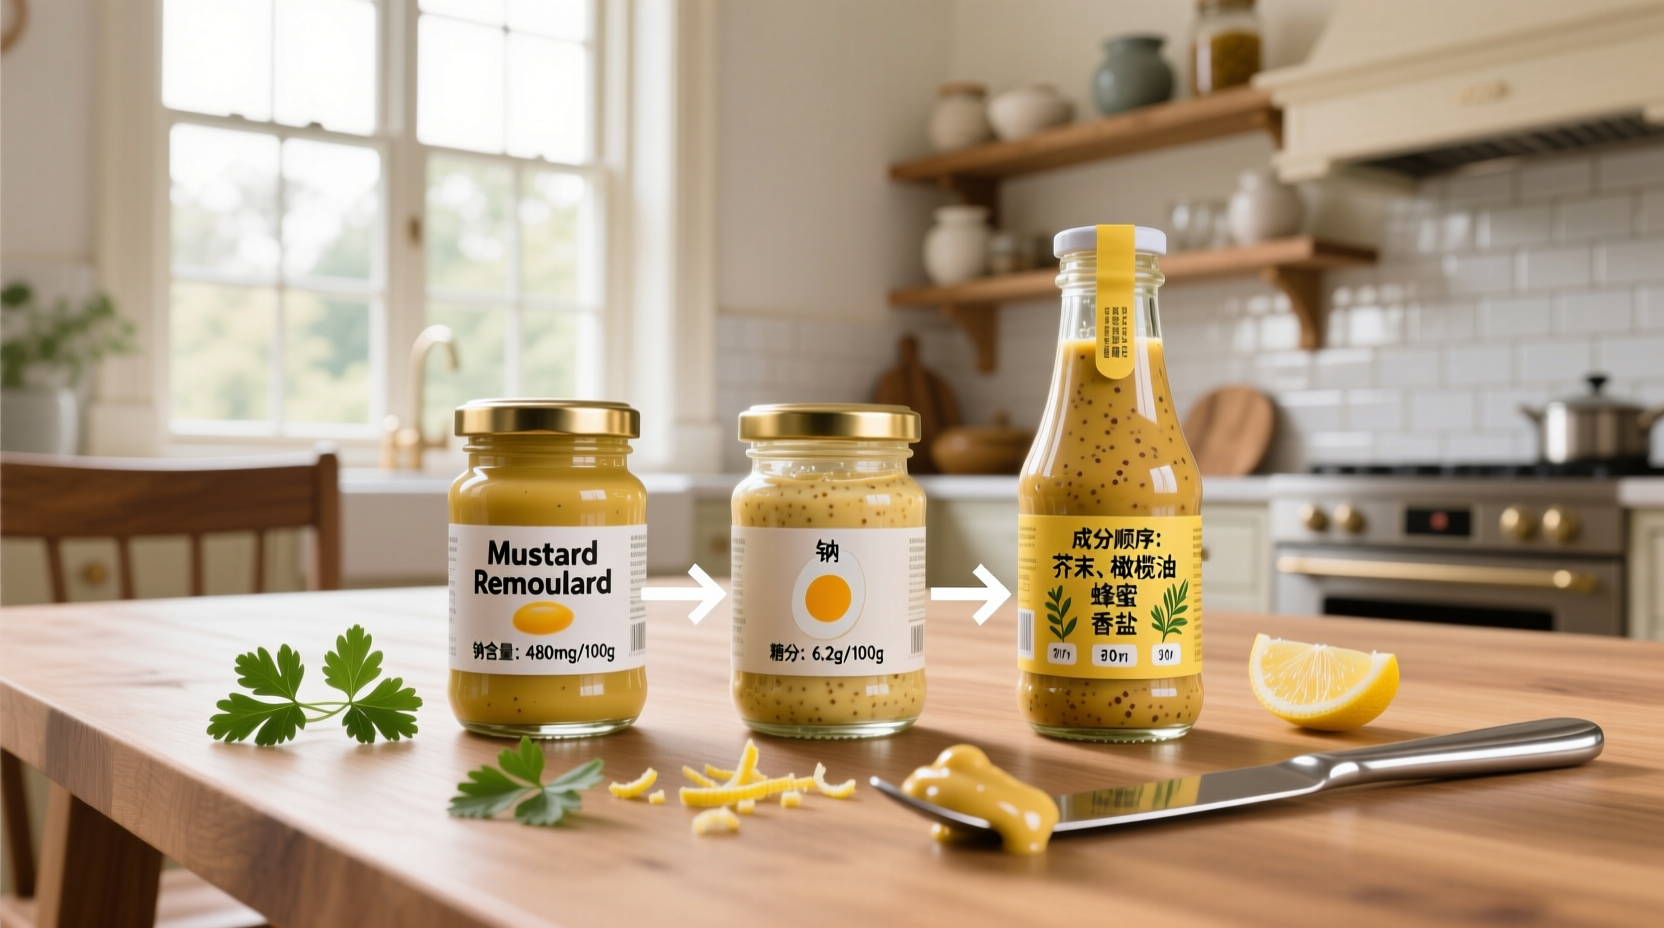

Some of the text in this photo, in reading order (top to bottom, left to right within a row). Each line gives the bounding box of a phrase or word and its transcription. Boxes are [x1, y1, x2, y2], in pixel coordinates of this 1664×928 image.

[488, 539, 598, 566] Mustard
[815, 538, 839, 563] 钠
[474, 568, 612, 595] Remoulard
[1090, 582, 1138, 608] 蜂蜜
[1091, 611, 1138, 636] 香盐
[525, 643, 615, 664] 480mg/100g
[812, 645, 884, 665] 6.2g/100g
